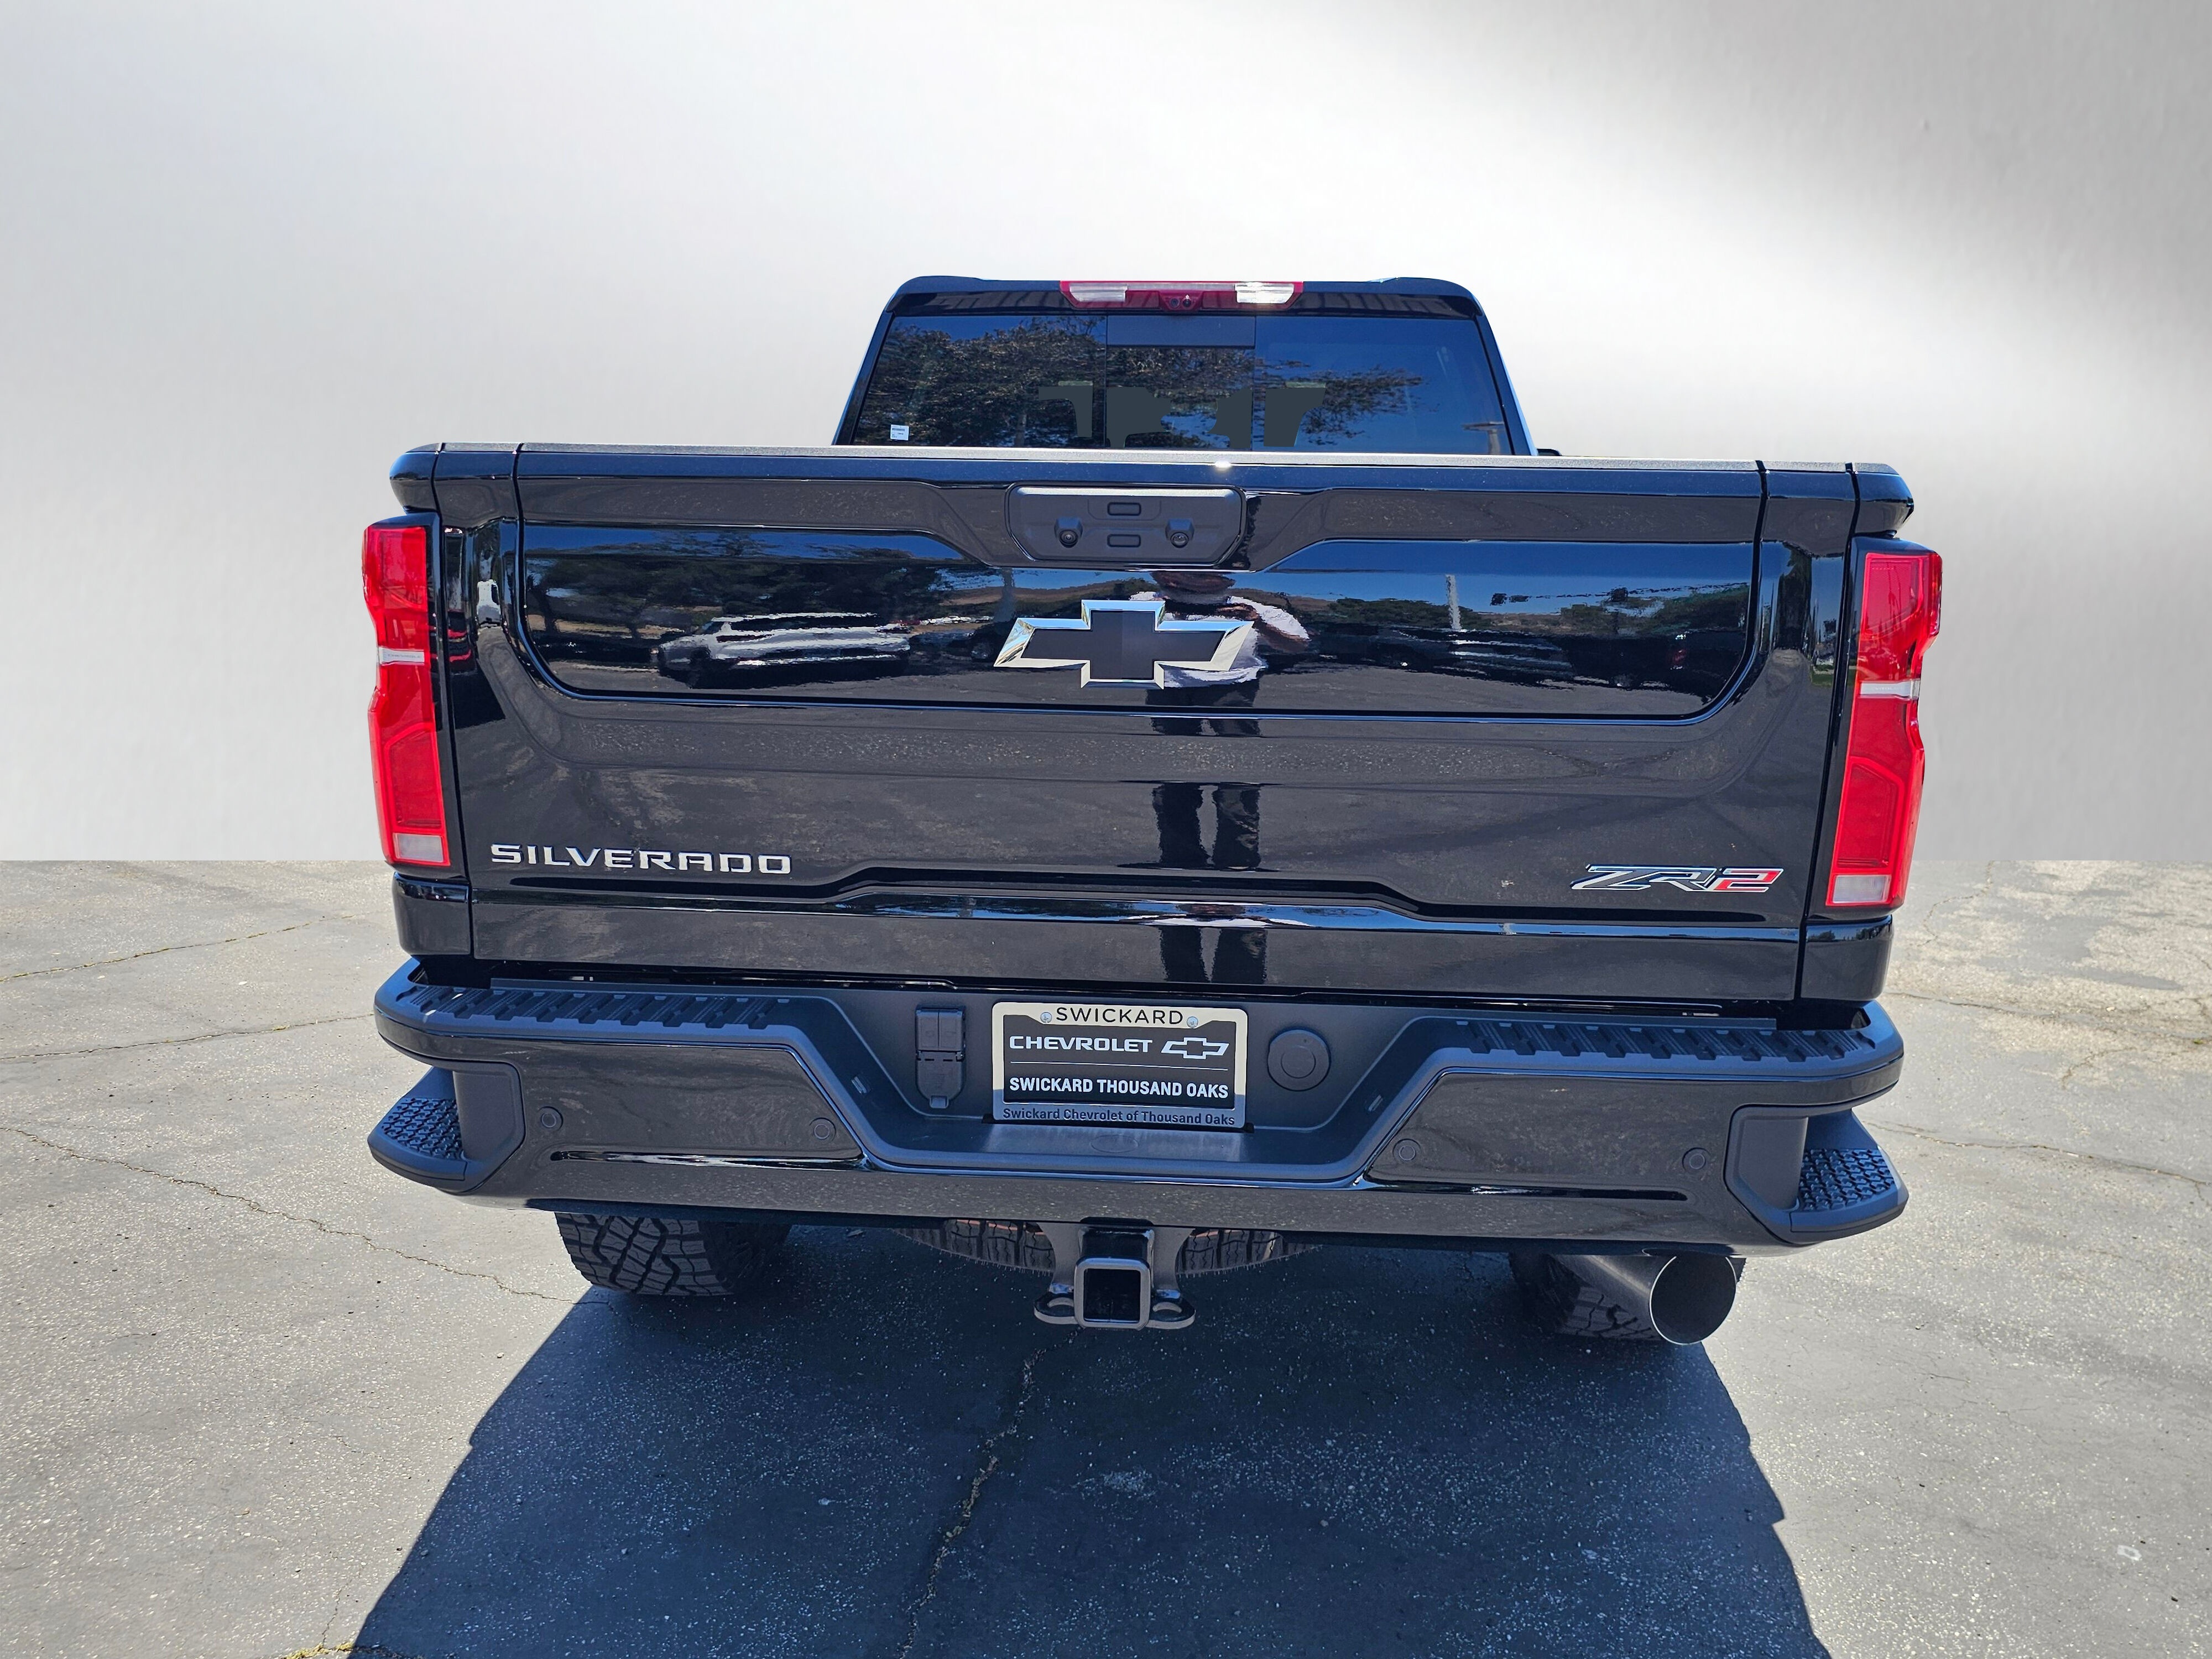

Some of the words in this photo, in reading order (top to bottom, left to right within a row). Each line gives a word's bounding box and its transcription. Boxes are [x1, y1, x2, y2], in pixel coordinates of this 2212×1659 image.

[491, 843, 792, 874] SILVERADO
[1570, 864, 1784, 893] ZR2
[1056, 1006, 1183, 1025] SWICKARD
[1009, 1036, 1153, 1053] CHEVROLET
[1009, 1077, 1093, 1093] SWICKARD
[1097, 1079, 1182, 1097] THOUSAND
[1186, 1083, 1229, 1099] OAKS
[1003, 1108, 1060, 1120] Swickard
[1063, 1109, 1123, 1122] Chevrolet
[1126, 1111, 1139, 1123] of
[1141, 1112, 1202, 1125] Thousand
[1205, 1114, 1235, 1126] Oaks
